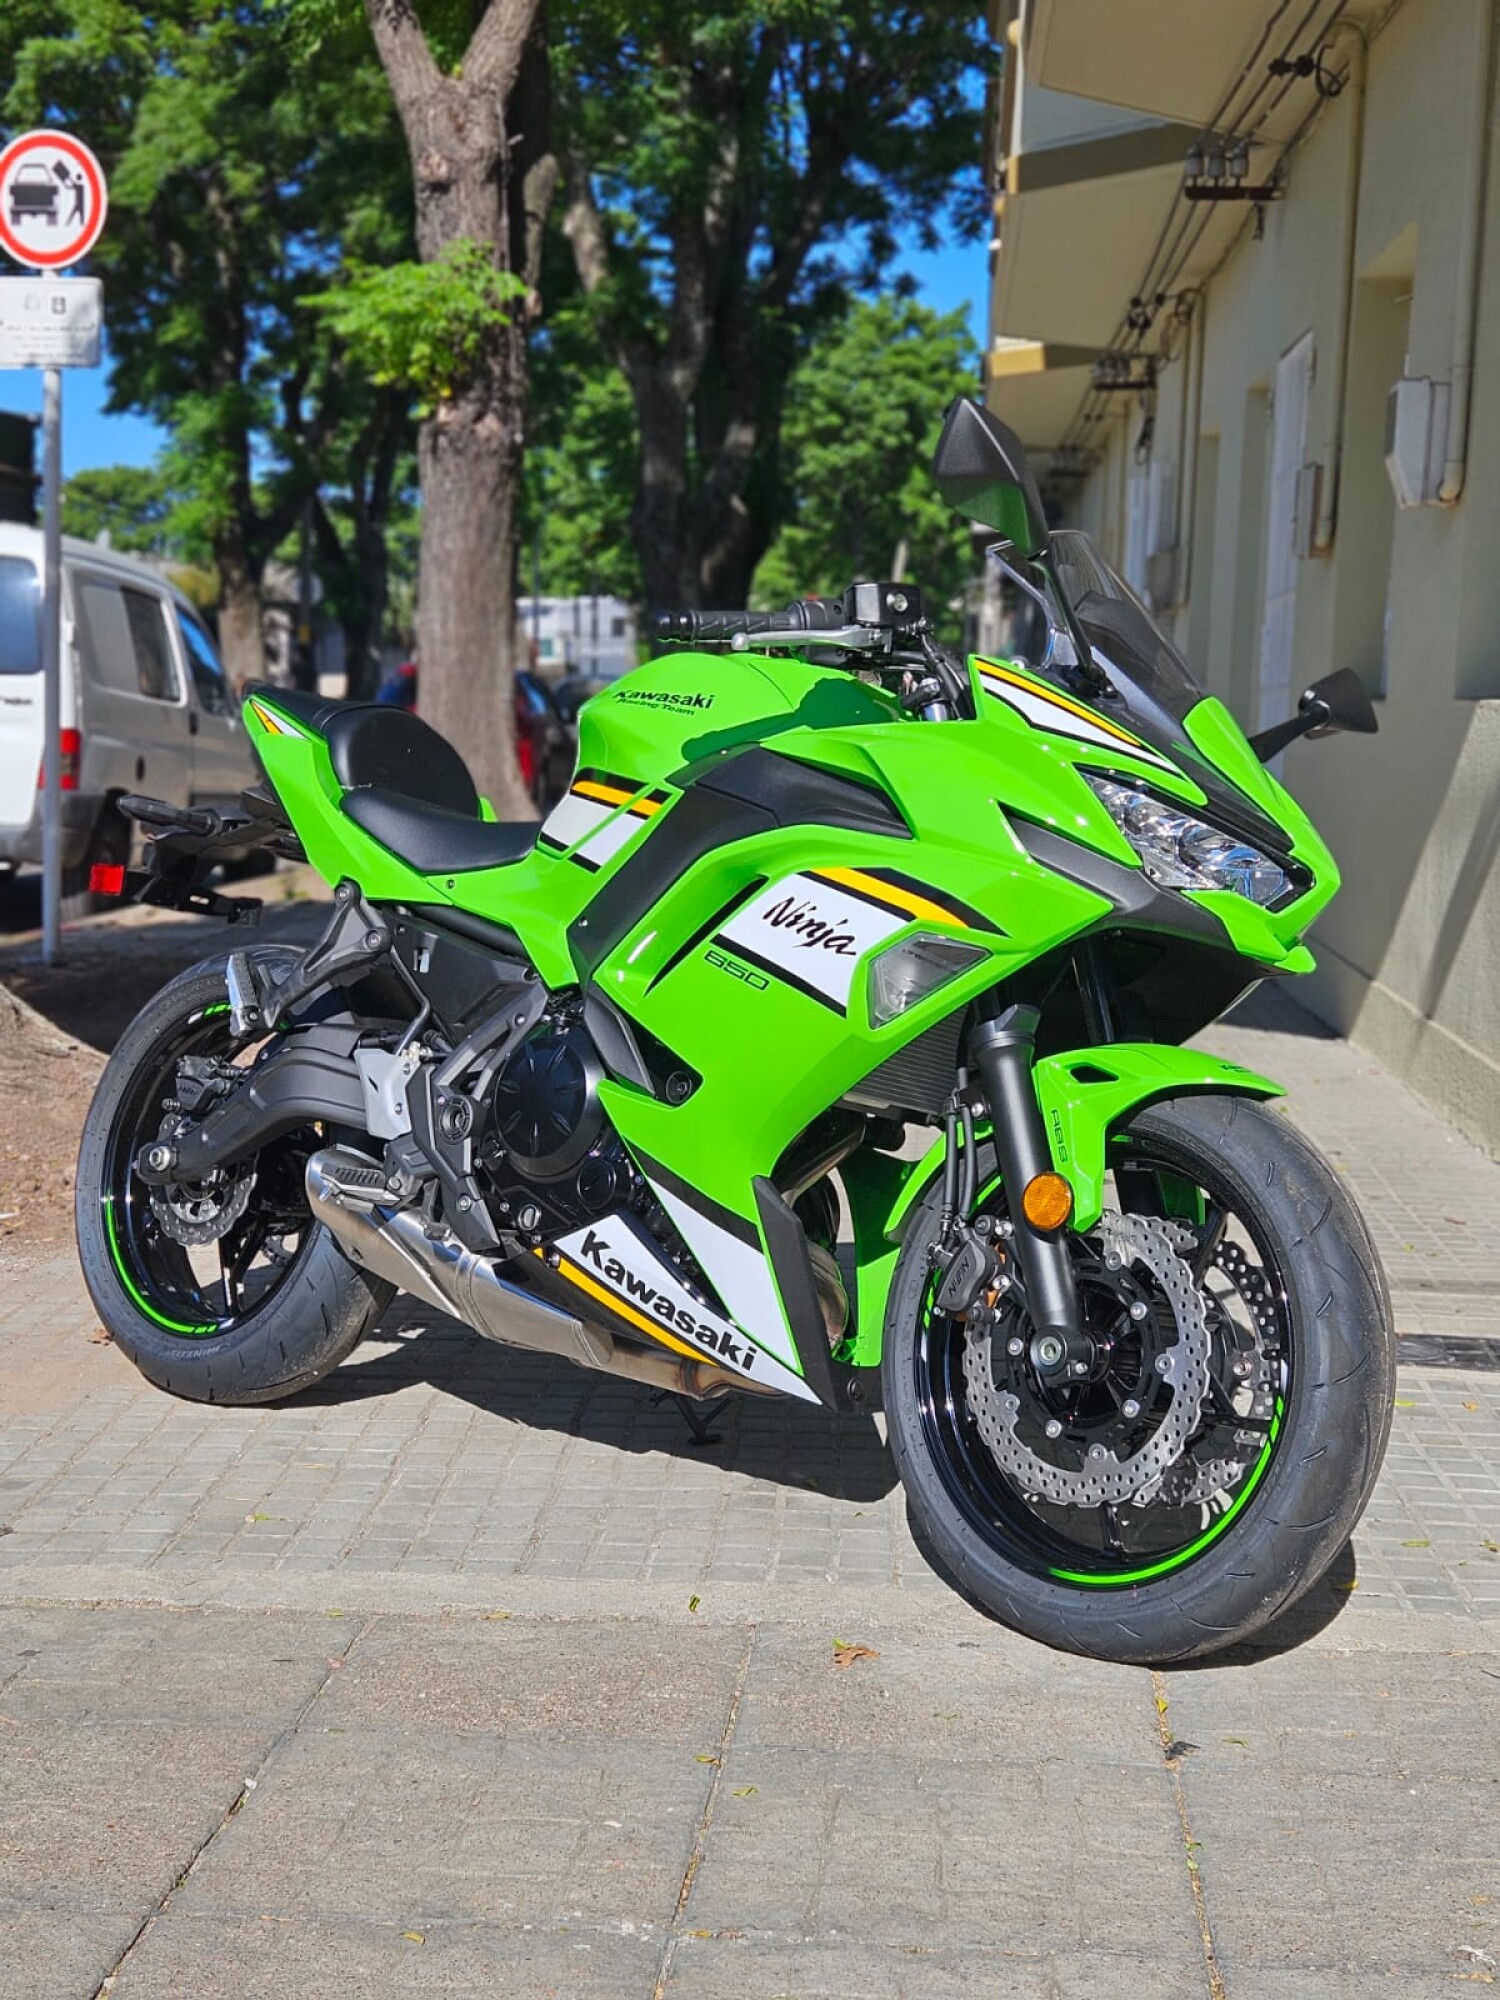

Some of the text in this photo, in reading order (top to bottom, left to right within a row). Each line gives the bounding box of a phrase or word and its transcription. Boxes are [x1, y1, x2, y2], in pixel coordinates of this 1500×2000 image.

[613, 690, 715, 709] Kawasaki
[662, 703, 695, 715] Team
[762, 896, 857, 956] Ninja
[704, 949, 770, 991] 650
[1051, 1109, 1068, 1162] ABS
[580, 1229, 757, 1371] Kawasaki
